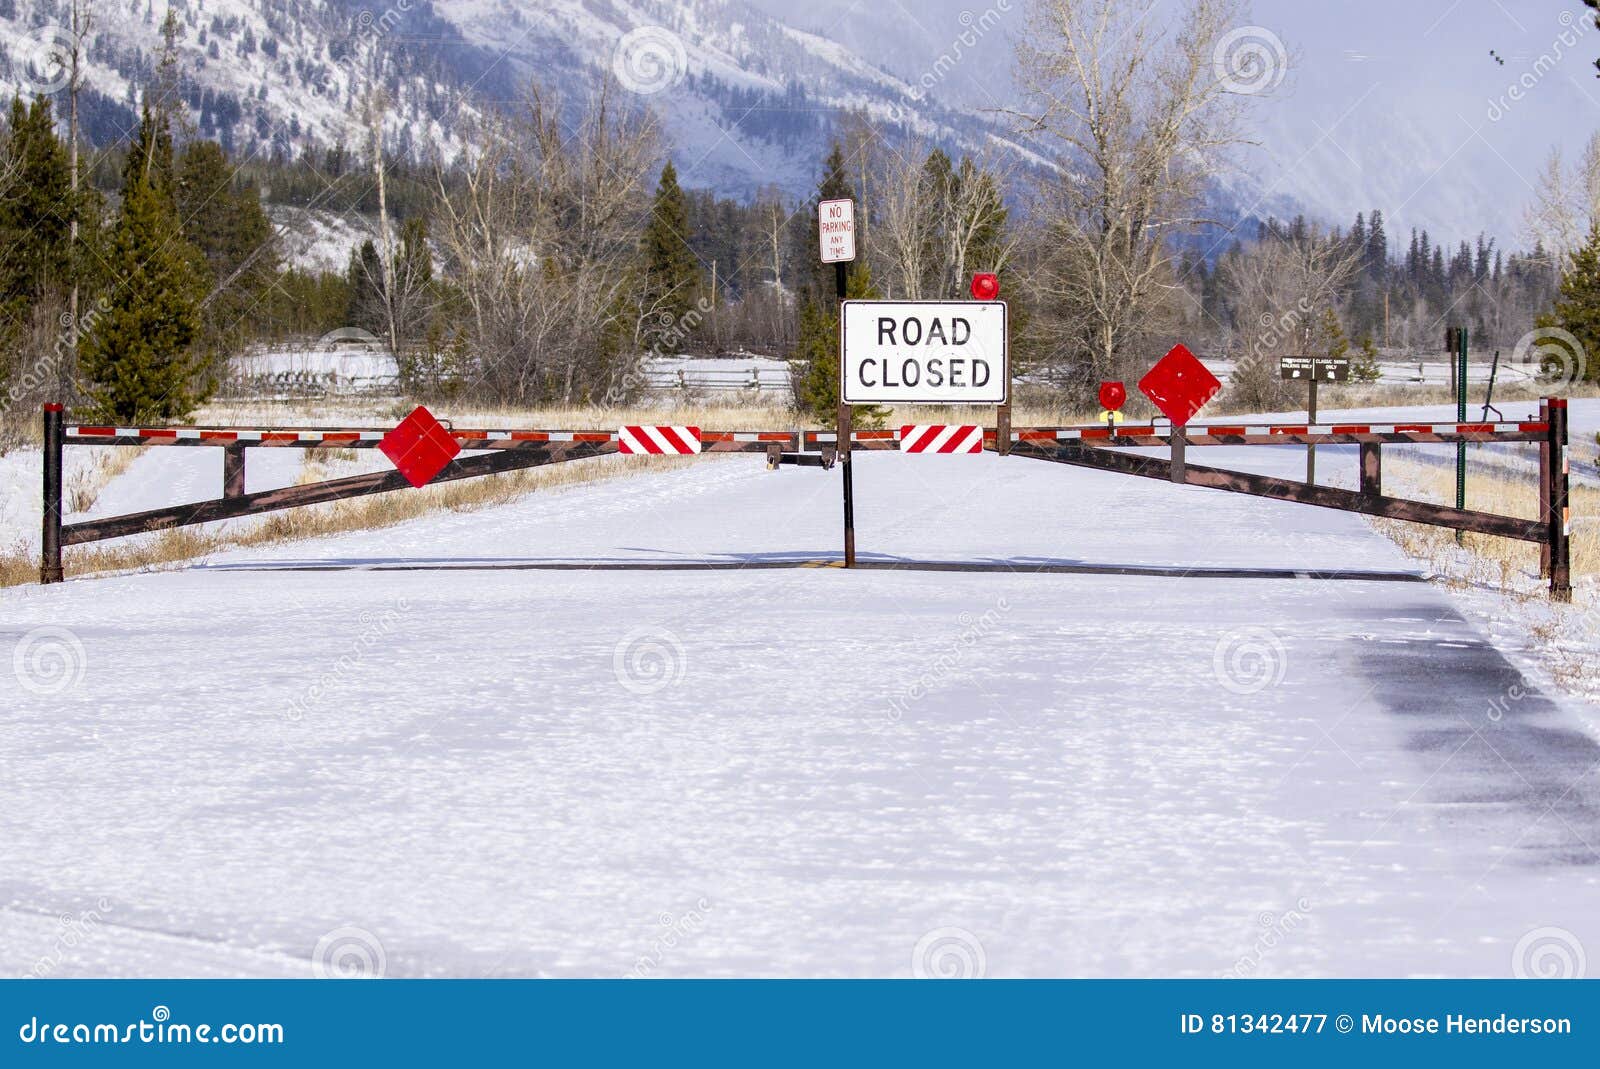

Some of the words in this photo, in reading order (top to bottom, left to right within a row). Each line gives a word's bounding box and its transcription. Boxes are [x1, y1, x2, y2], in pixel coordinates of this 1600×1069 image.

[829, 206, 842, 218] NO
[822, 220, 851, 234] PARKING
[830, 236, 844, 244] ANY
[829, 246, 846, 255] TIME
[878, 316, 971, 346] ROAD
[858, 358, 991, 388] CLOSED
